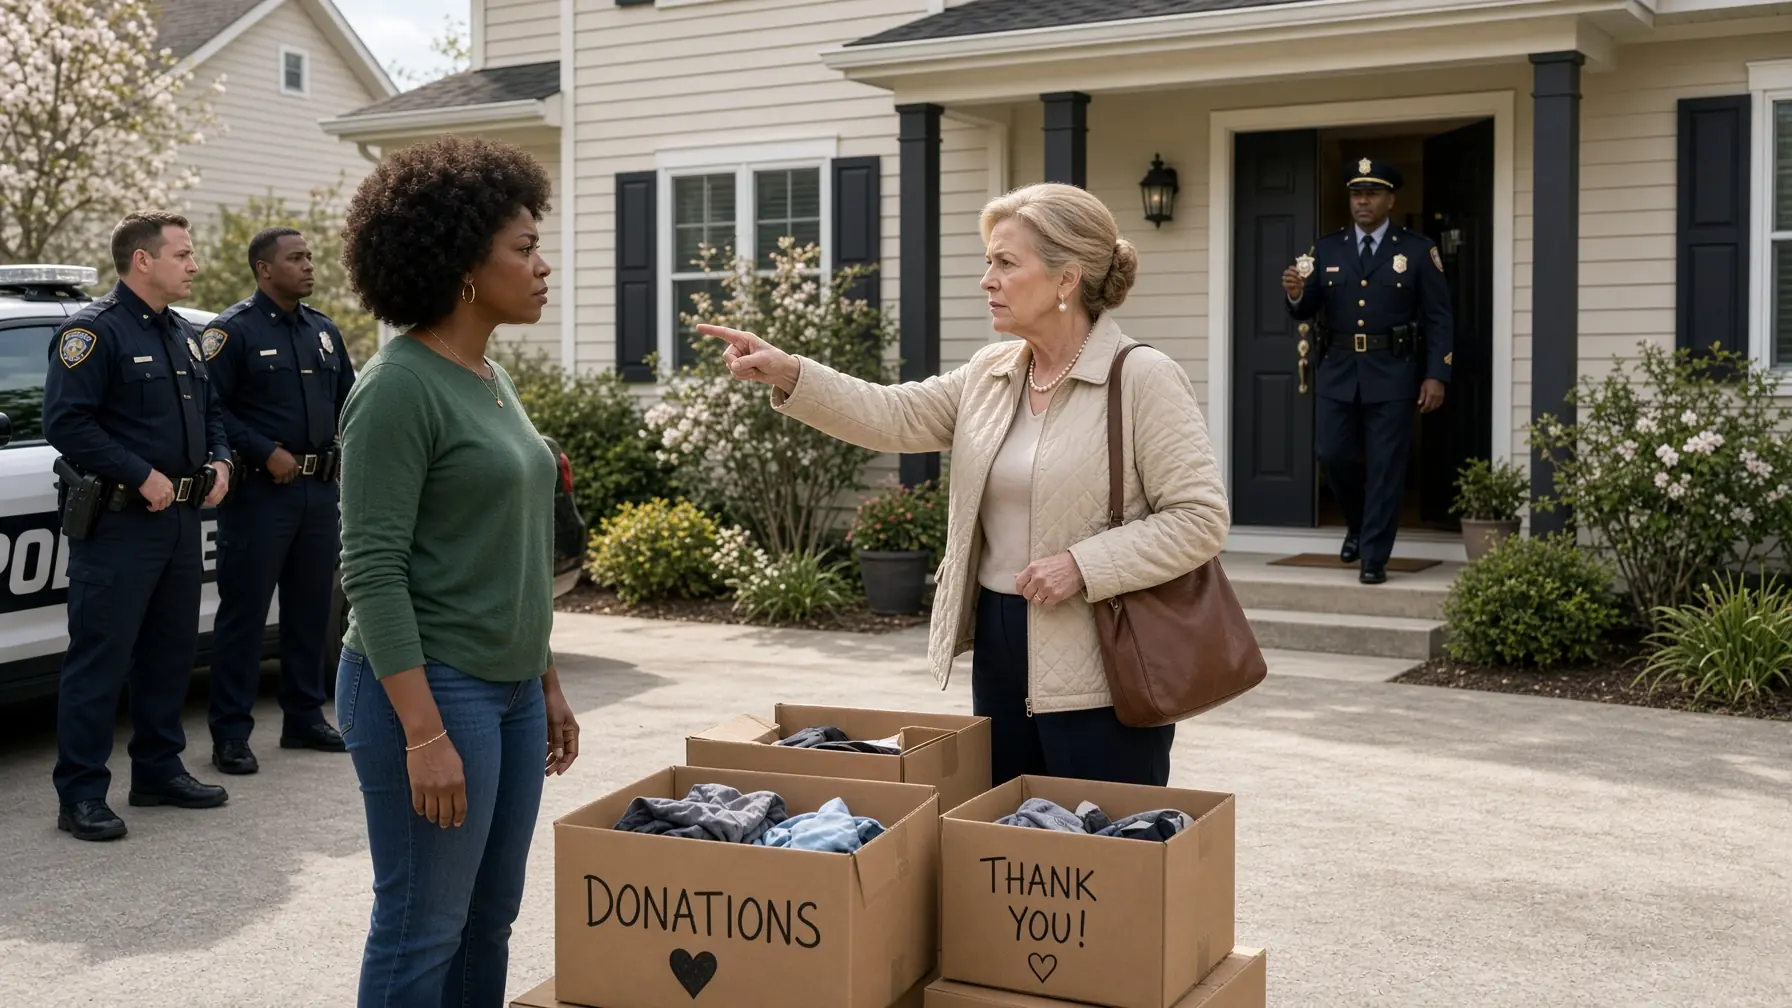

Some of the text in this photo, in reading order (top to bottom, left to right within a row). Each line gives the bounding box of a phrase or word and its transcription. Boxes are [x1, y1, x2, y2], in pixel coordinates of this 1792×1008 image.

[0, 520, 218, 596] OLE
[979, 856, 1097, 902] THANK
[584, 874, 821, 949] DONATIONS
[1008, 905, 1086, 948] YOU!
